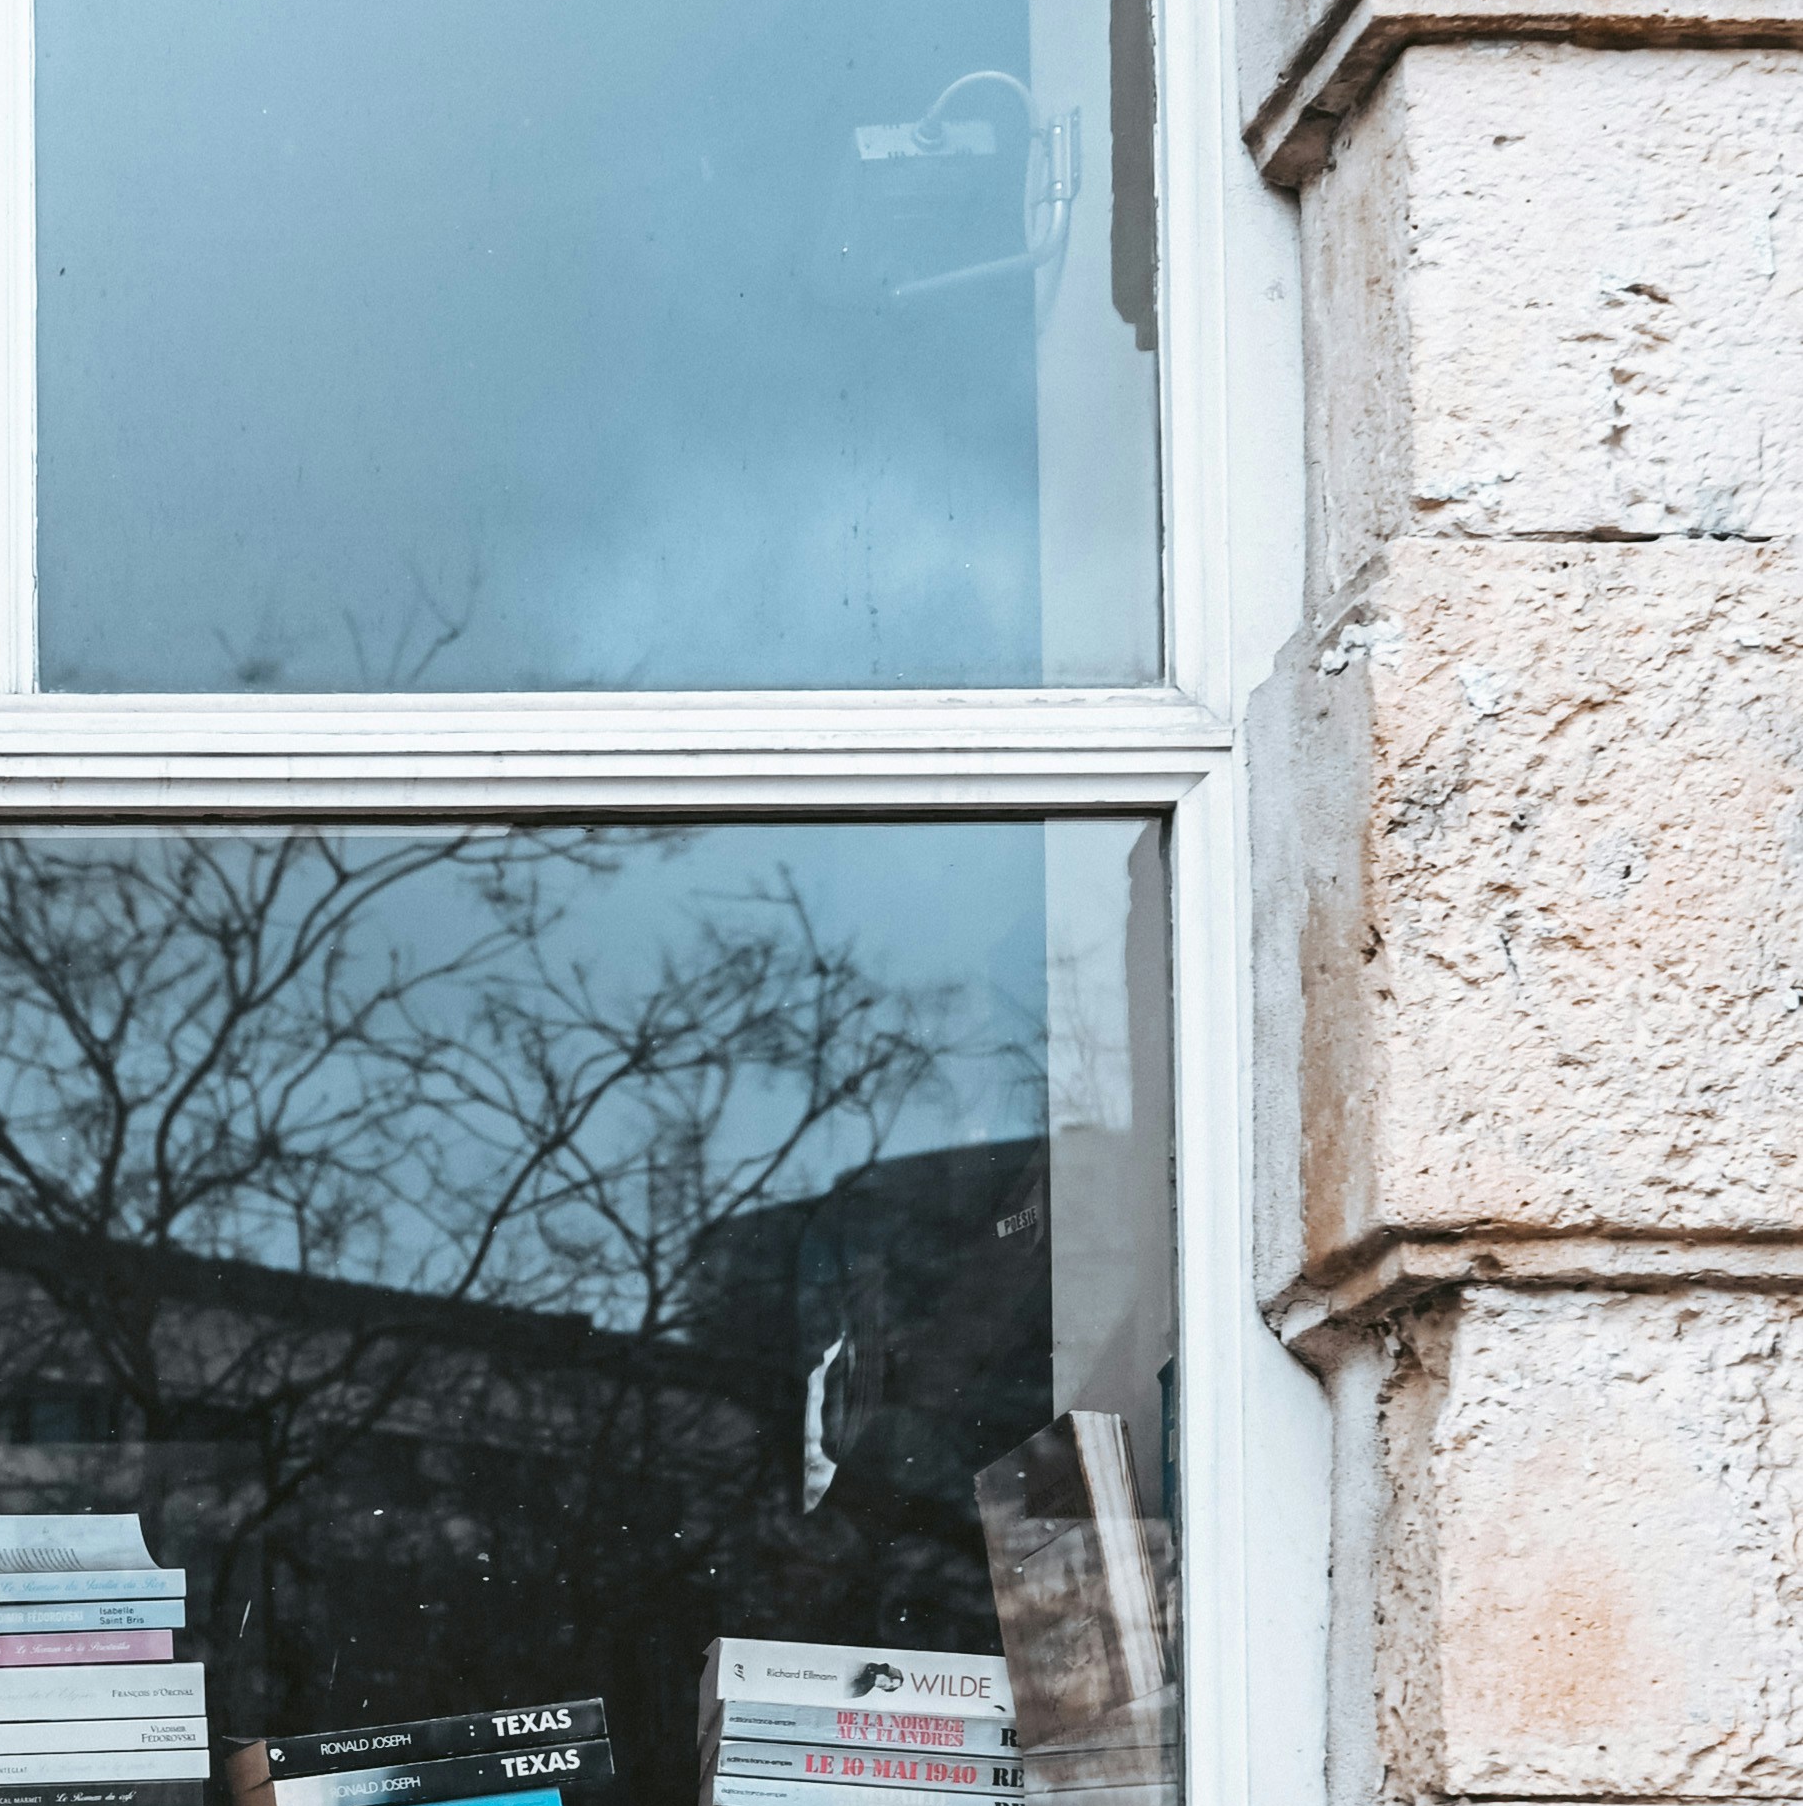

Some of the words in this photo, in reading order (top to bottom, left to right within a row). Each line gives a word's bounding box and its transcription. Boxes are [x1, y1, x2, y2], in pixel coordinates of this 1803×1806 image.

[99, 1606, 135, 1616] Isabelle
[99, 1616, 122, 1626] Saint
[126, 1615, 145, 1625] Bris
[766, 1668, 801, 1680] Richard
[803, 1671, 838, 1682] Ellmann
[910, 1673, 992, 1699] WILDE
[492, 1708, 573, 1737] TEXAS
[320, 1738, 369, 1756] RONALD
[371, 1734, 412, 1750] JOSEPH
[501, 1749, 581, 1778] TEXAS
[805, 1754, 834, 1774] LE
[841, 1757, 864, 1776] 10
[872, 1758, 918, 1780] MAI
[924, 1762, 977, 1784] 1940
